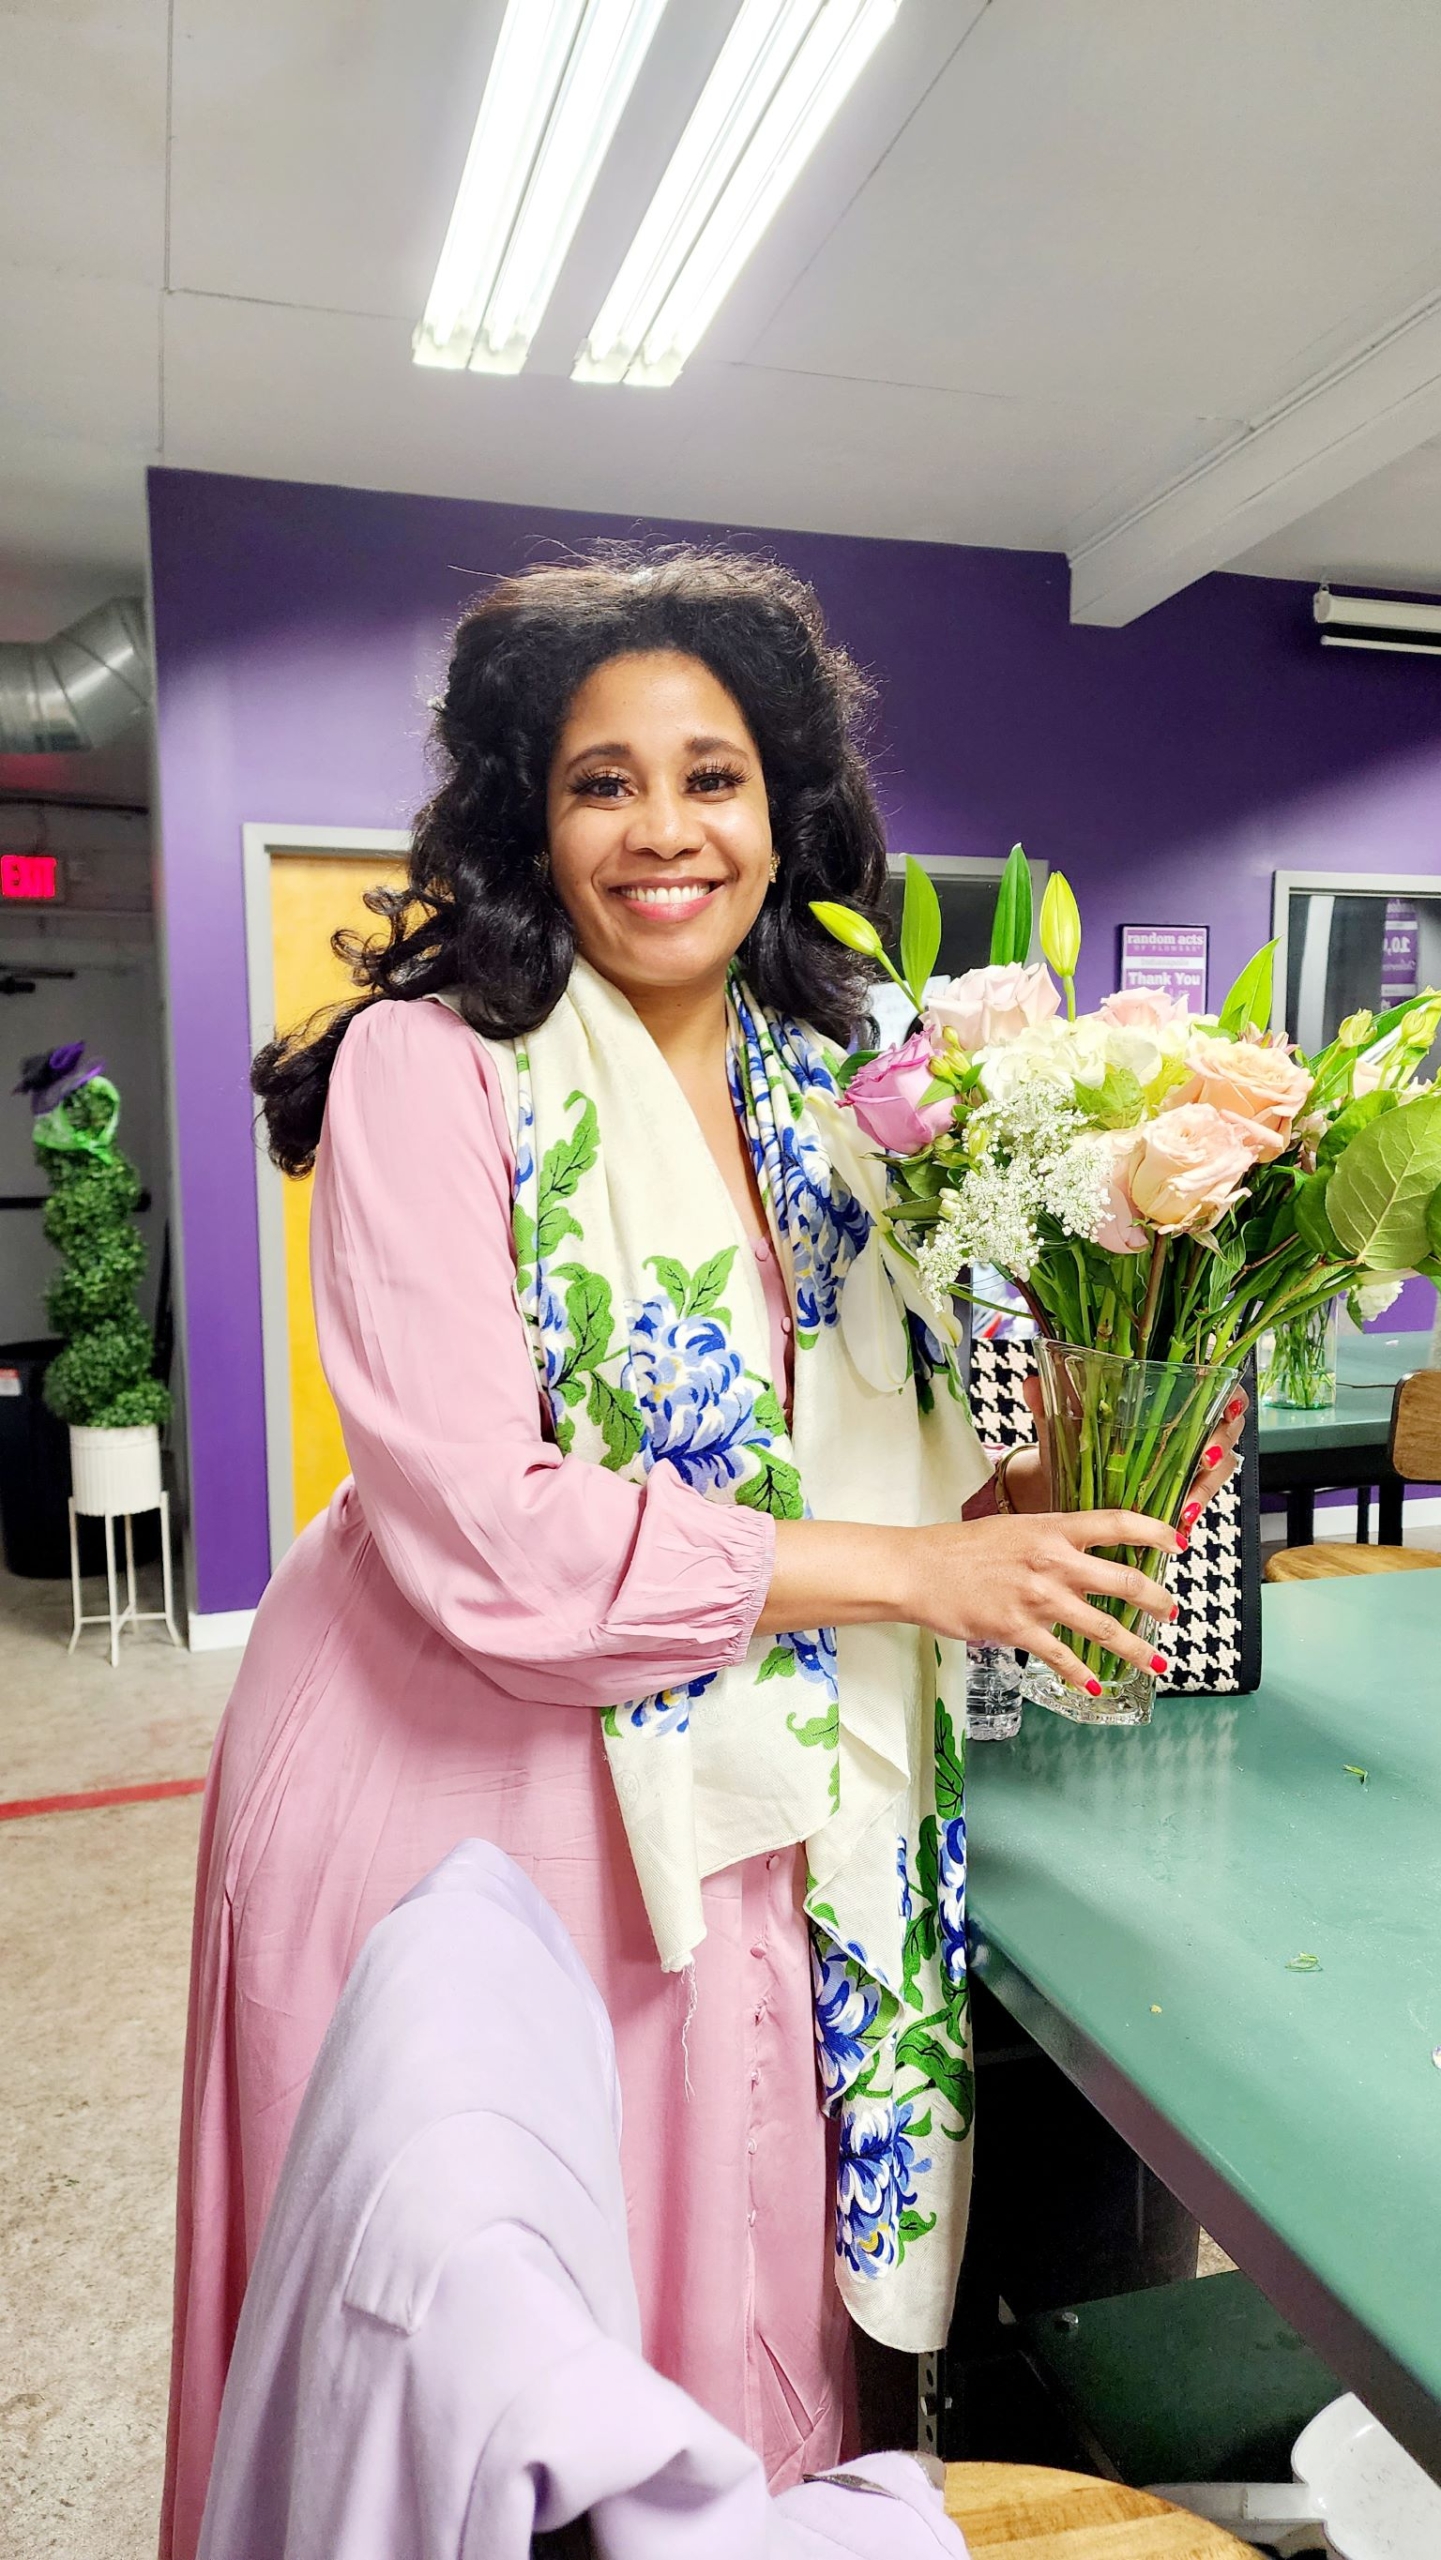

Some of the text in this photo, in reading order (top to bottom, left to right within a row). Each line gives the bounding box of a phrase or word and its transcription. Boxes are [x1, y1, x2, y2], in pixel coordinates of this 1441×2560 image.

[4, 858, 55, 896] EXIT
[1127, 932, 1204, 946] random acts
[1127, 971, 1201, 986] Thank You
